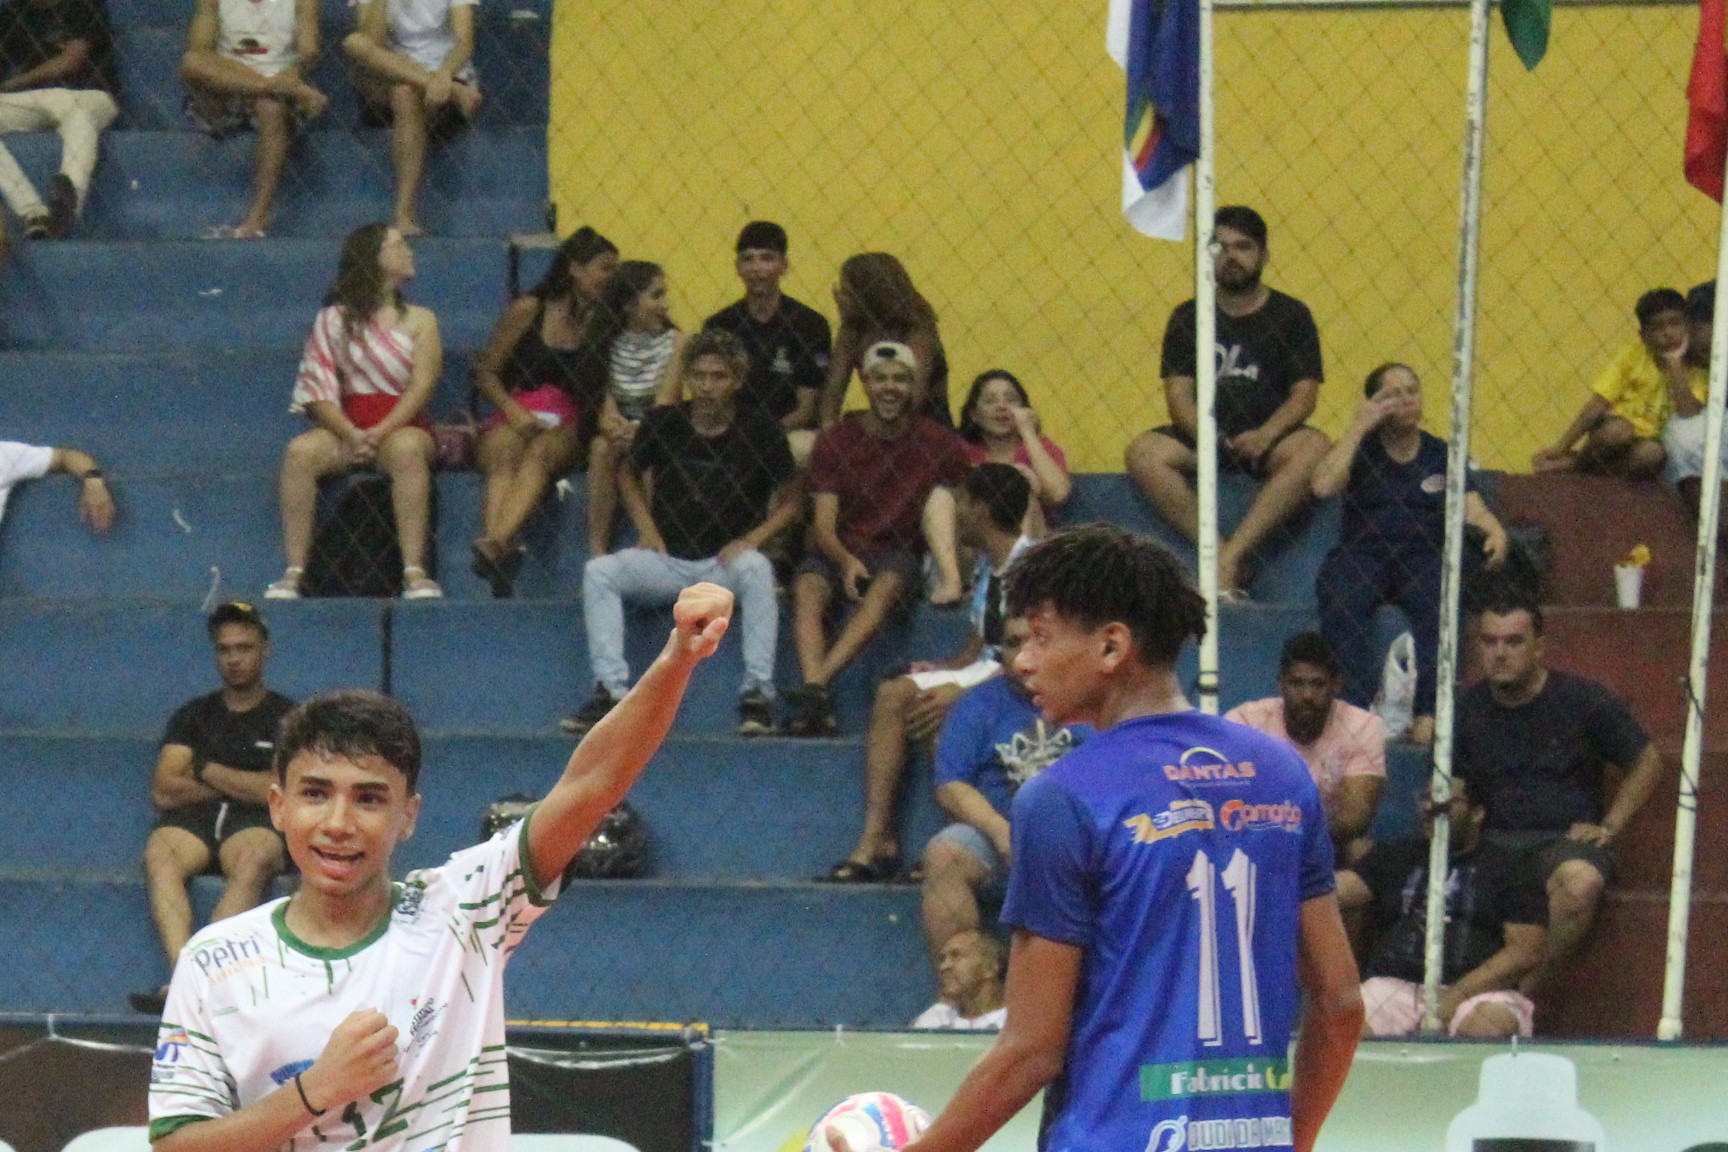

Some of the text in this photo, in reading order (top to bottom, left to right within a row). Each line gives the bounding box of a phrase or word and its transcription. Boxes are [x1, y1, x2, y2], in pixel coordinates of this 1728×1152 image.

[1162, 761, 1257, 780] DANTAS
[1185, 848, 1262, 1046] 11
[342, 1077, 409, 1152] 12
